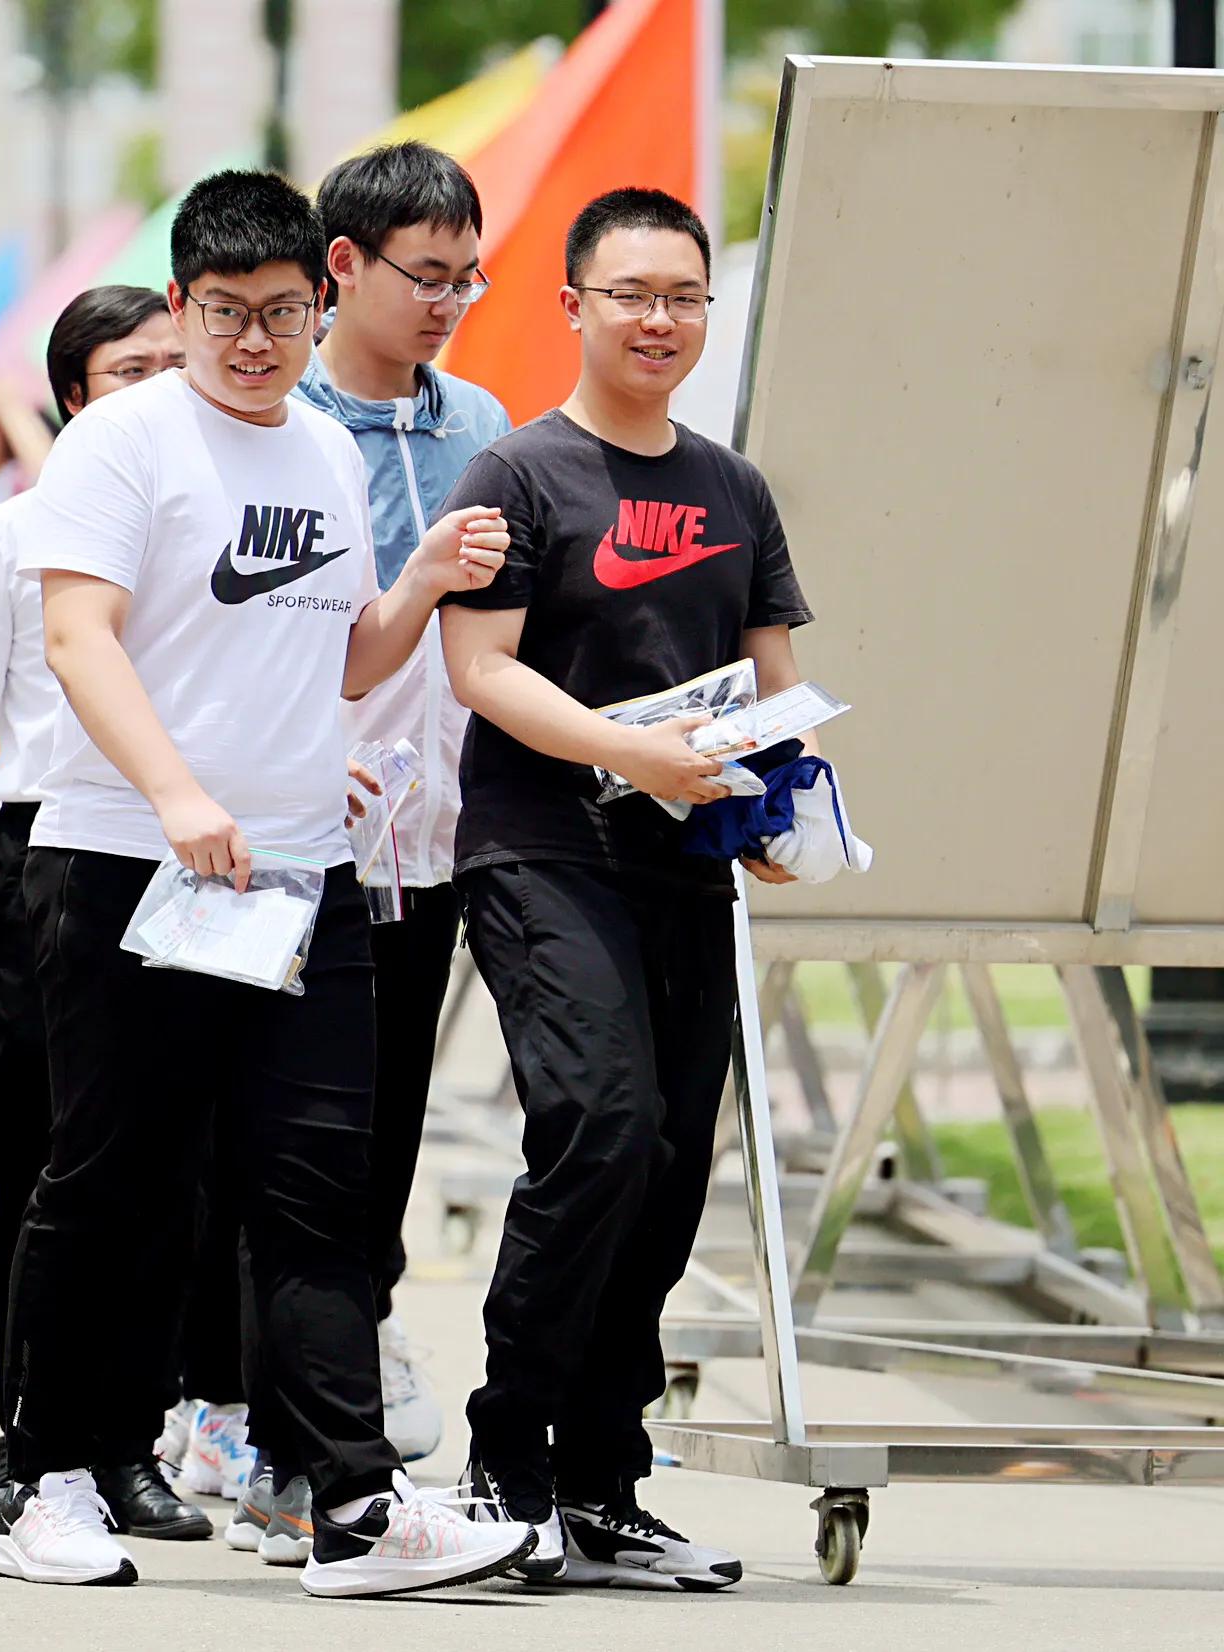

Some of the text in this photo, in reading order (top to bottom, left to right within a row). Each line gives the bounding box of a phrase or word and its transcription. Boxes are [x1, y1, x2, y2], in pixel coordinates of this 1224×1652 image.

[236, 504, 325, 562] NIKE
[615, 499, 707, 554] NIKE
[267, 594, 352, 614] SPORTSWEAR
